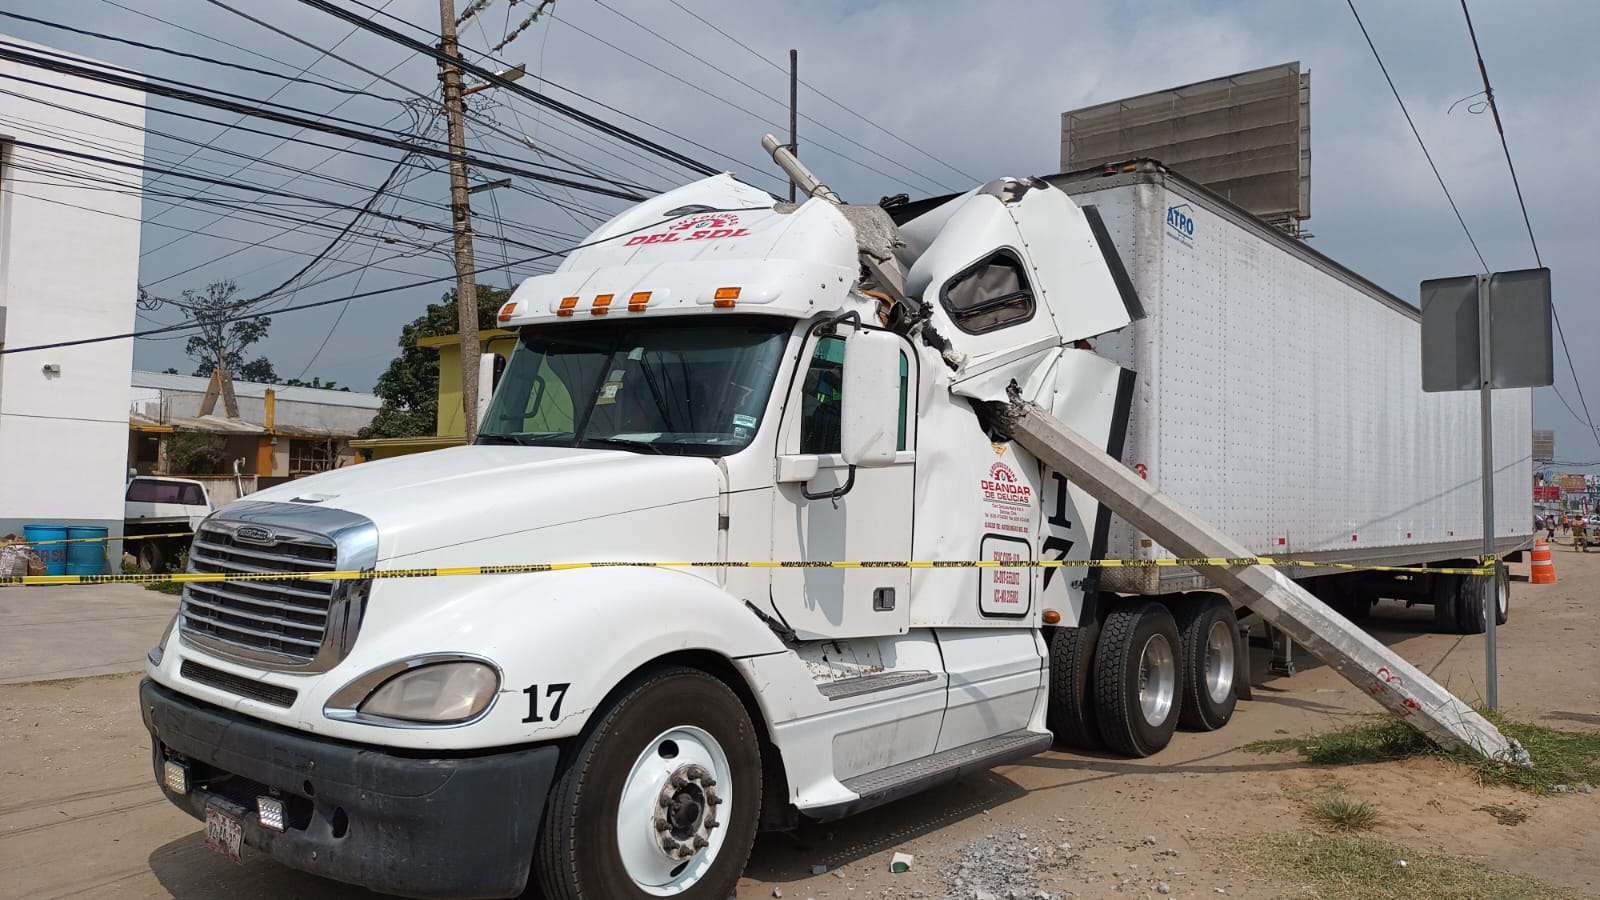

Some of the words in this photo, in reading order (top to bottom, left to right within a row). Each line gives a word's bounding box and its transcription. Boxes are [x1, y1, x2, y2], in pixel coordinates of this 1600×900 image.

[624, 233, 680, 246] DEL
[981, 480, 1031, 496] DEANDAR
[984, 491, 996, 499] DE
[997, 492, 1029, 504] DELICIAS
[521, 682, 572, 724] 17
